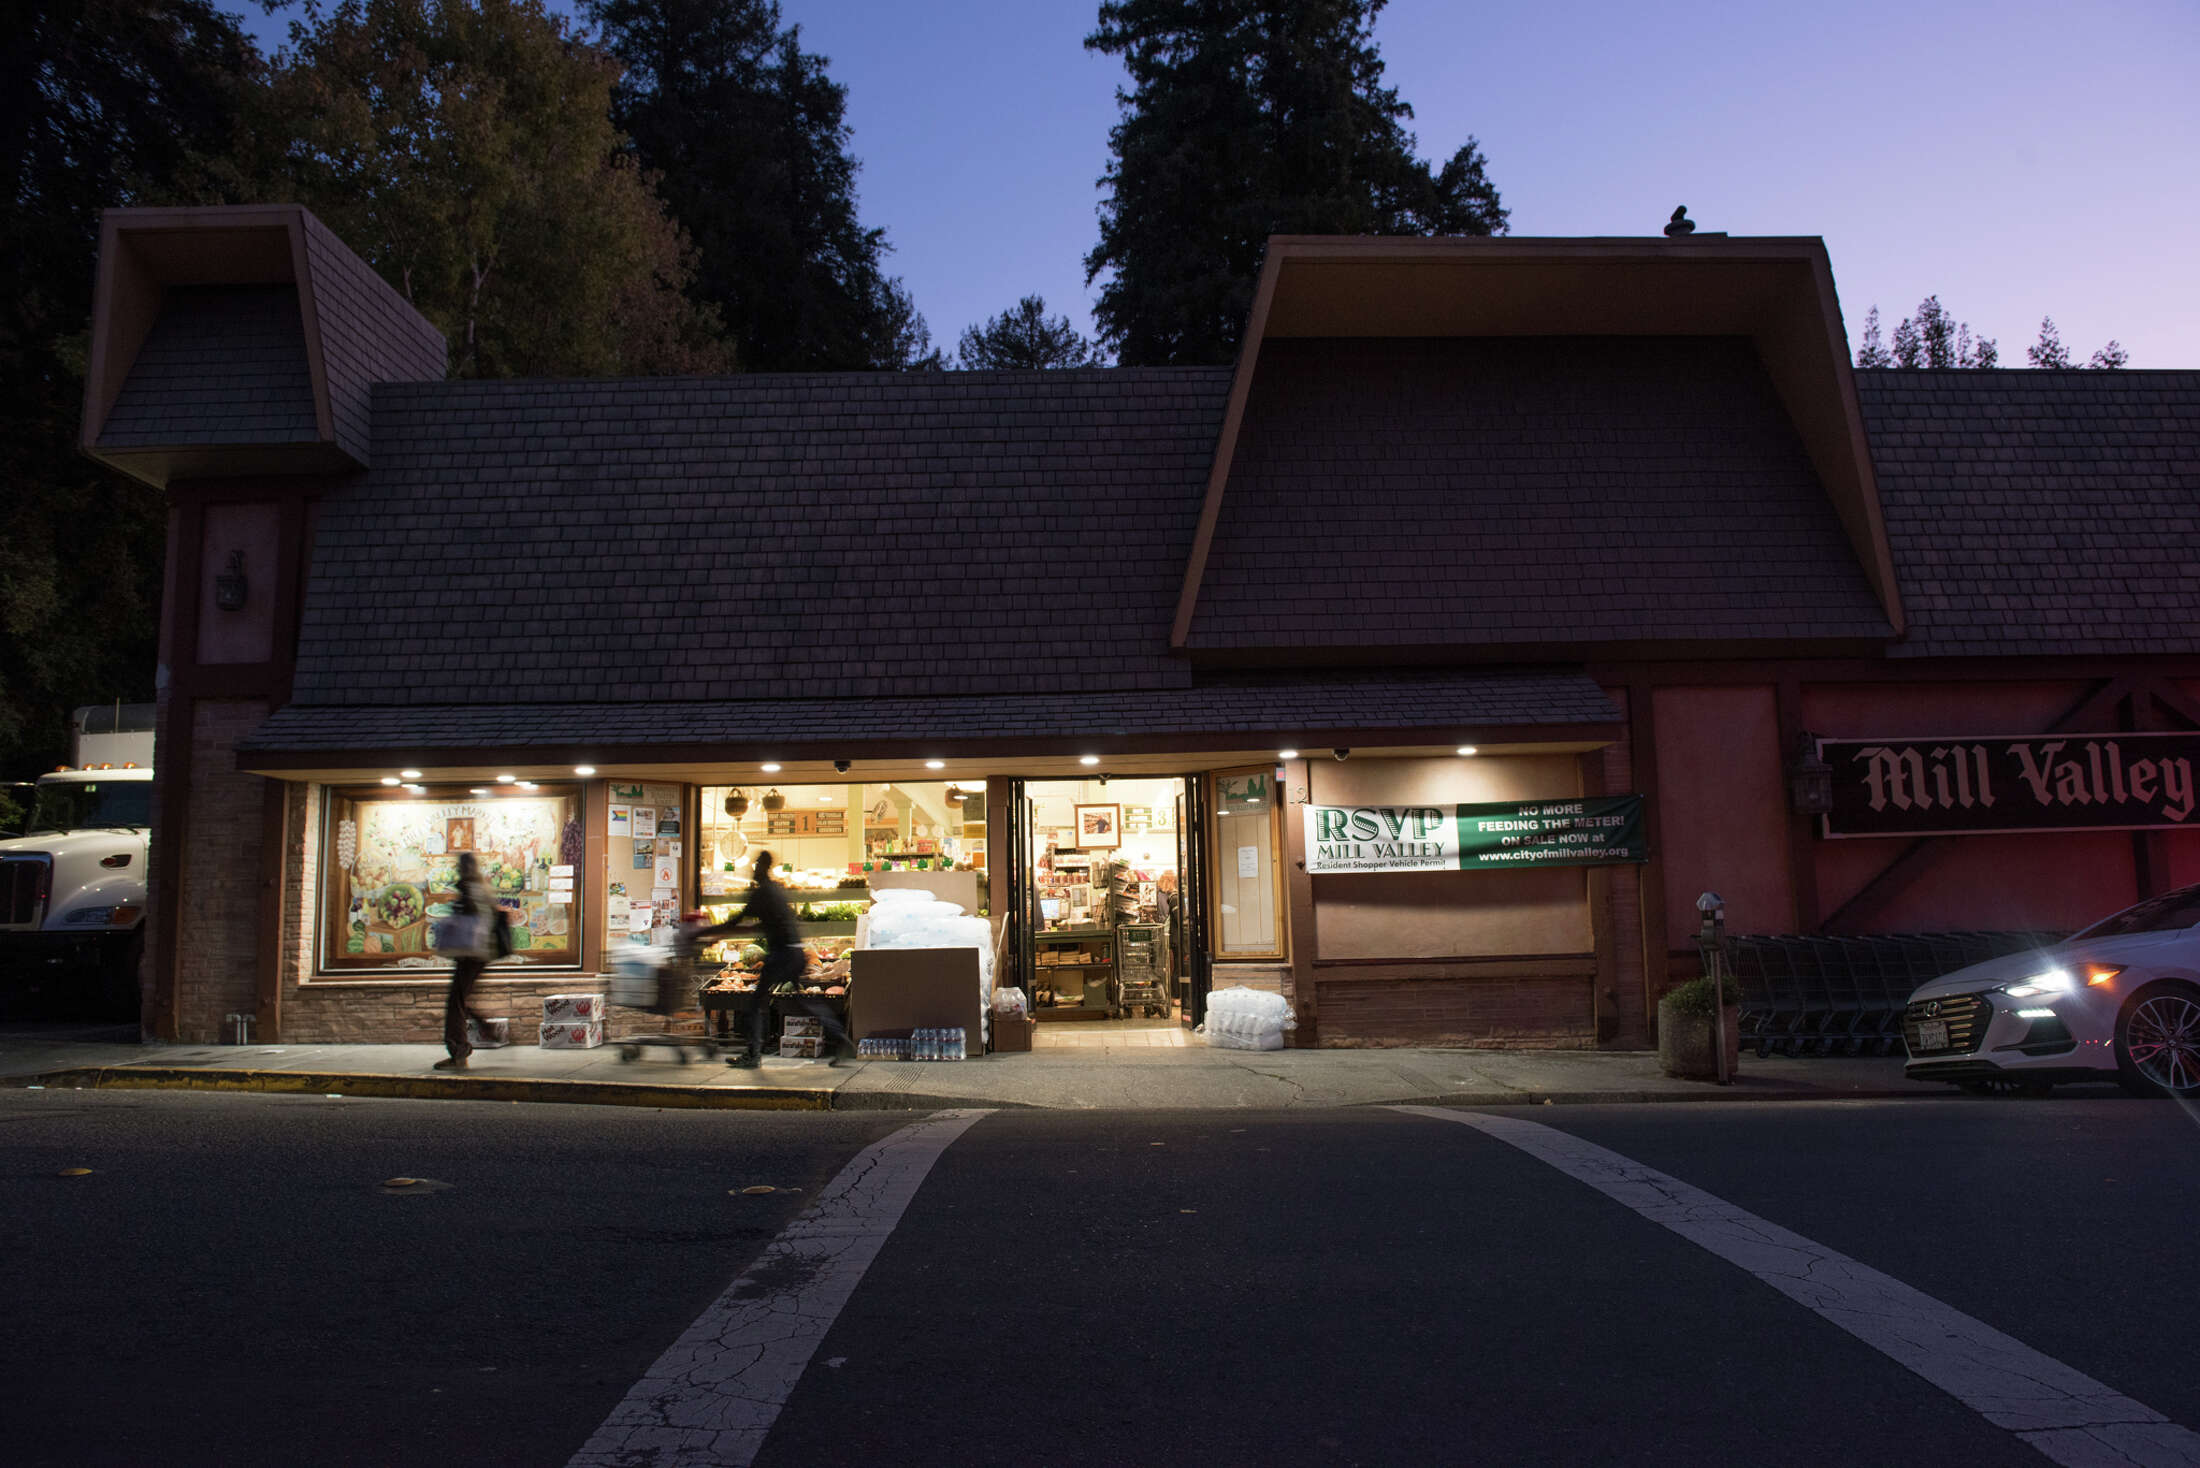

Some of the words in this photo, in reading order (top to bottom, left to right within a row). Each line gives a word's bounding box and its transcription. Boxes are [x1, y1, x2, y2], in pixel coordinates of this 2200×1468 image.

[1852, 745, 1996, 812] Mill
[2006, 740, 2195, 822] Valley
[1519, 806, 1539, 816] NO
[1543, 803, 1584, 815] MORE
[1316, 808, 1444, 842] RSVP
[1478, 820, 1539, 832] FEEDING
[1542, 818, 1571, 830] THE
[1574, 815, 1625, 828] METER!
[1501, 836, 1520, 847] ON
[1524, 833, 1556, 846] SALE
[1559, 832, 1589, 844] NOW
[1592, 833, 1606, 843] at
[1318, 844, 1366, 859] MILL
[1372, 842, 1445, 858] VALLEY
[1478, 847, 1630, 862] www.cityofmillvalley.org
[1316, 861, 1351, 870] Resident
[1353, 861, 1387, 872] Shopper
[1389, 858, 1419, 868] Vehicle
[1420, 858, 1446, 867] Permit
